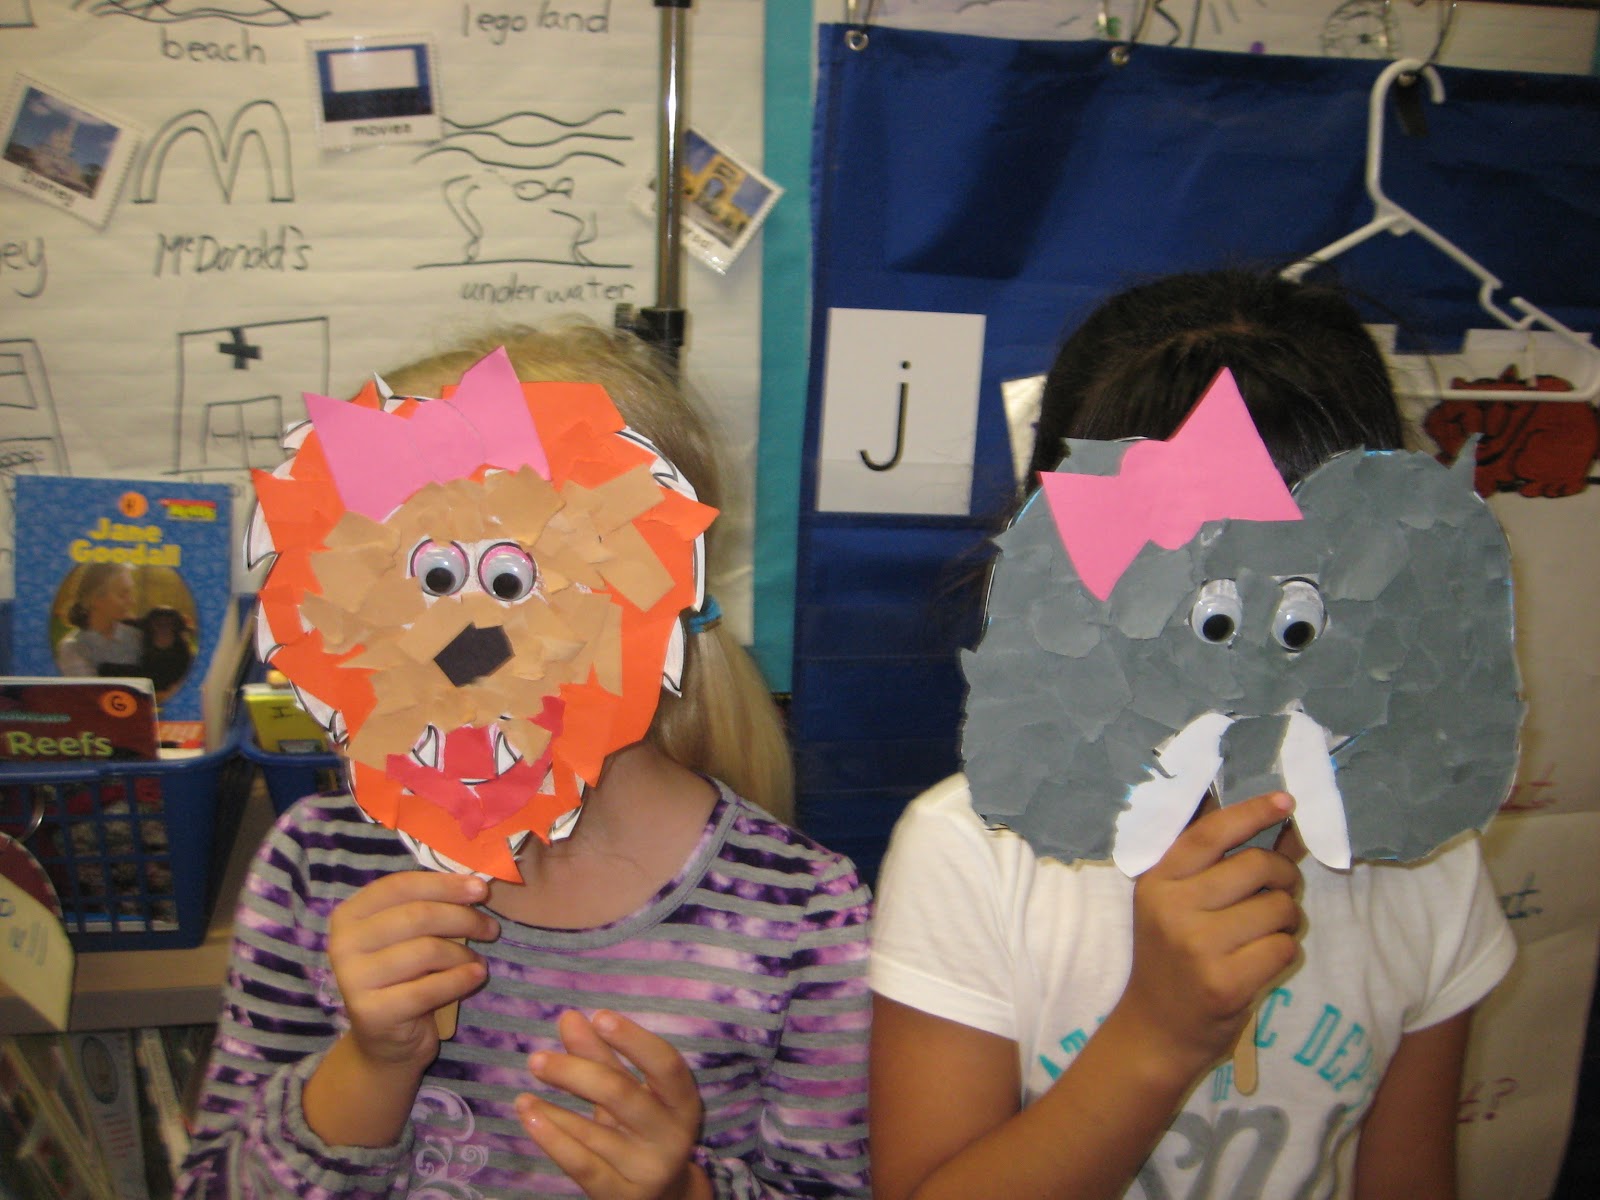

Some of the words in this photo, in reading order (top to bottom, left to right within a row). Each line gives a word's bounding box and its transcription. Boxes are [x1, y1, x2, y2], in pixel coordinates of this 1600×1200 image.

[160, 27, 266, 63] beach
[0, 236, 48, 298] ey
[154, 225, 312, 278] McDonald's
[859, 360, 912, 472] j
[88, 517, 163, 543] Jane
[69, 539, 181, 567] Goodall
[7, 731, 113, 757] Reefs
